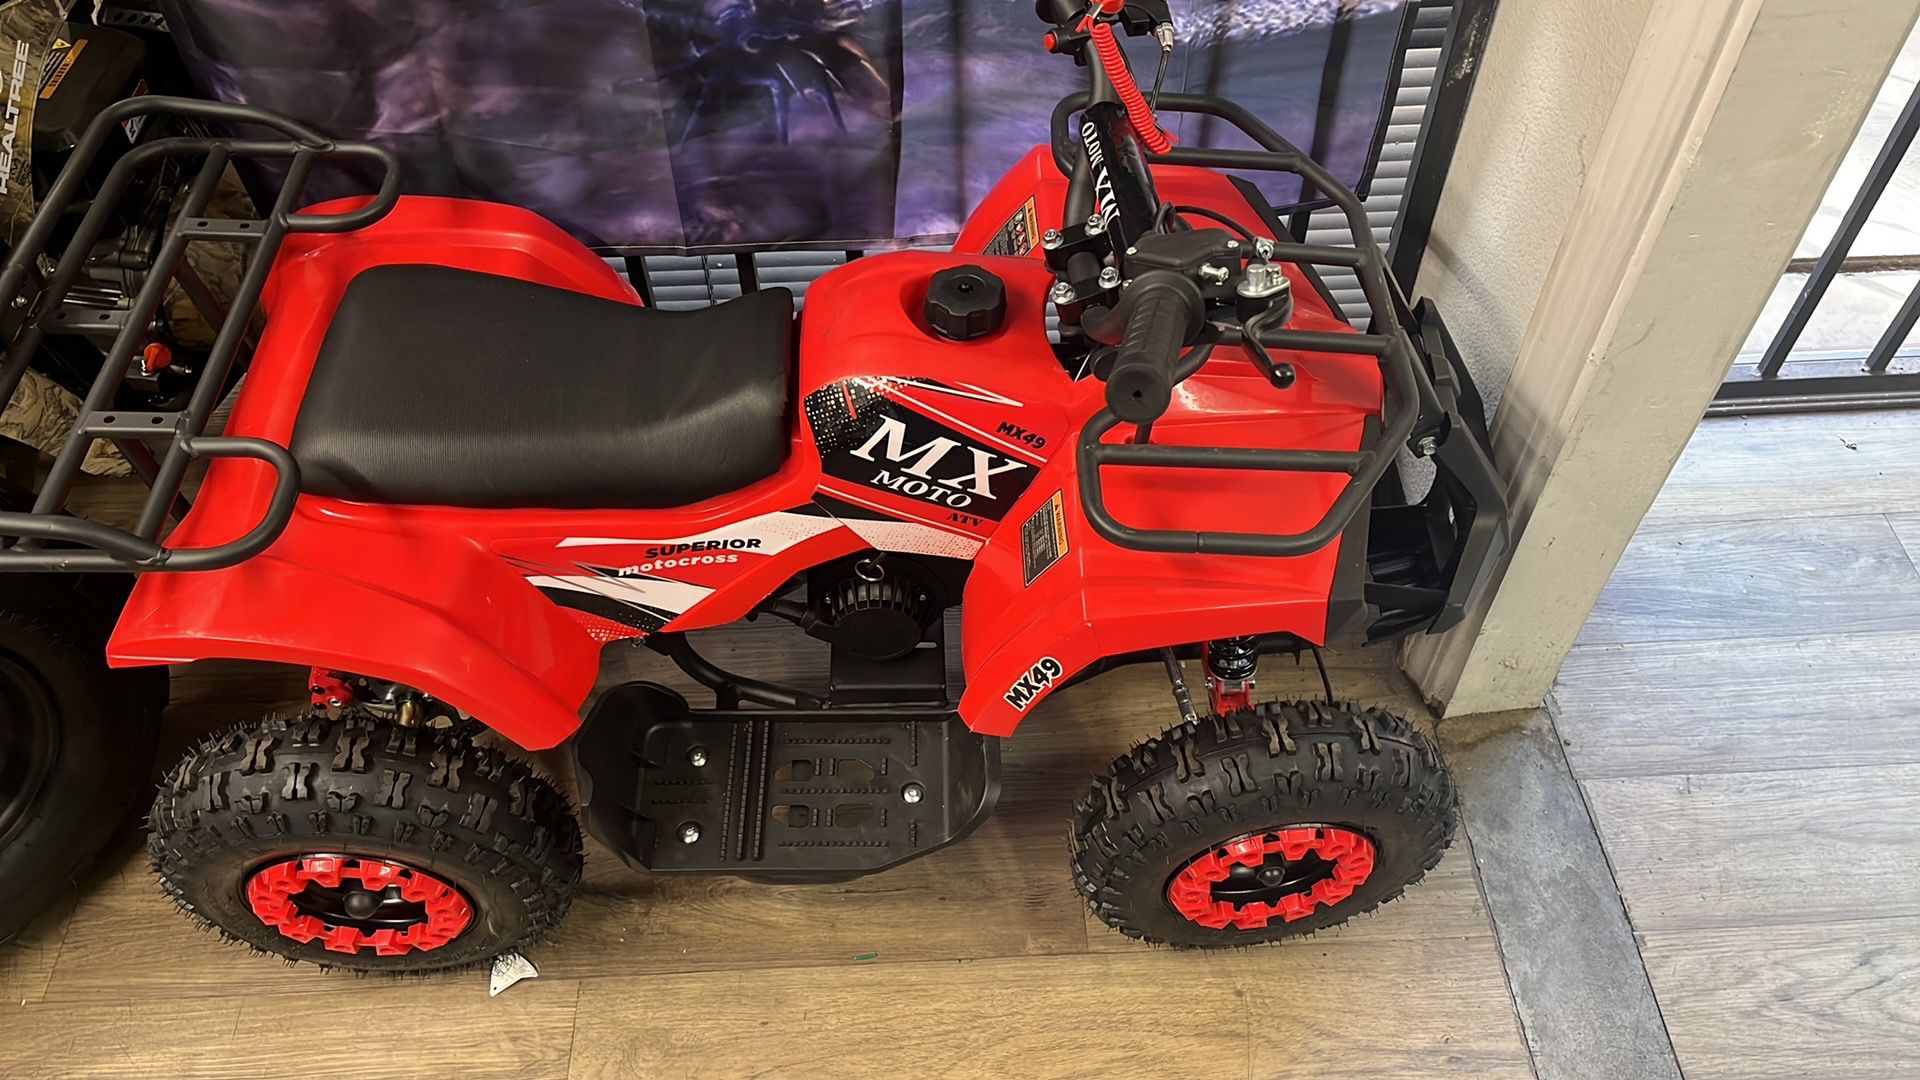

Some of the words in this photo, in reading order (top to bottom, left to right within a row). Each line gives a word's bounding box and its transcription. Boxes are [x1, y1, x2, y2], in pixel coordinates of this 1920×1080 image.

[1082, 122, 1104, 170] MOTO
[996, 421, 1046, 449] MX49
[850, 414, 1027, 499] MX
[870, 469, 972, 508] MOTO
[946, 512, 984, 527] ATV
[1055, 509, 1064, 546] WARNING
[618, 553, 739, 577] motocross
[645, 538, 762, 559] SUPERIOR
[1005, 657, 1062, 711] MX49
